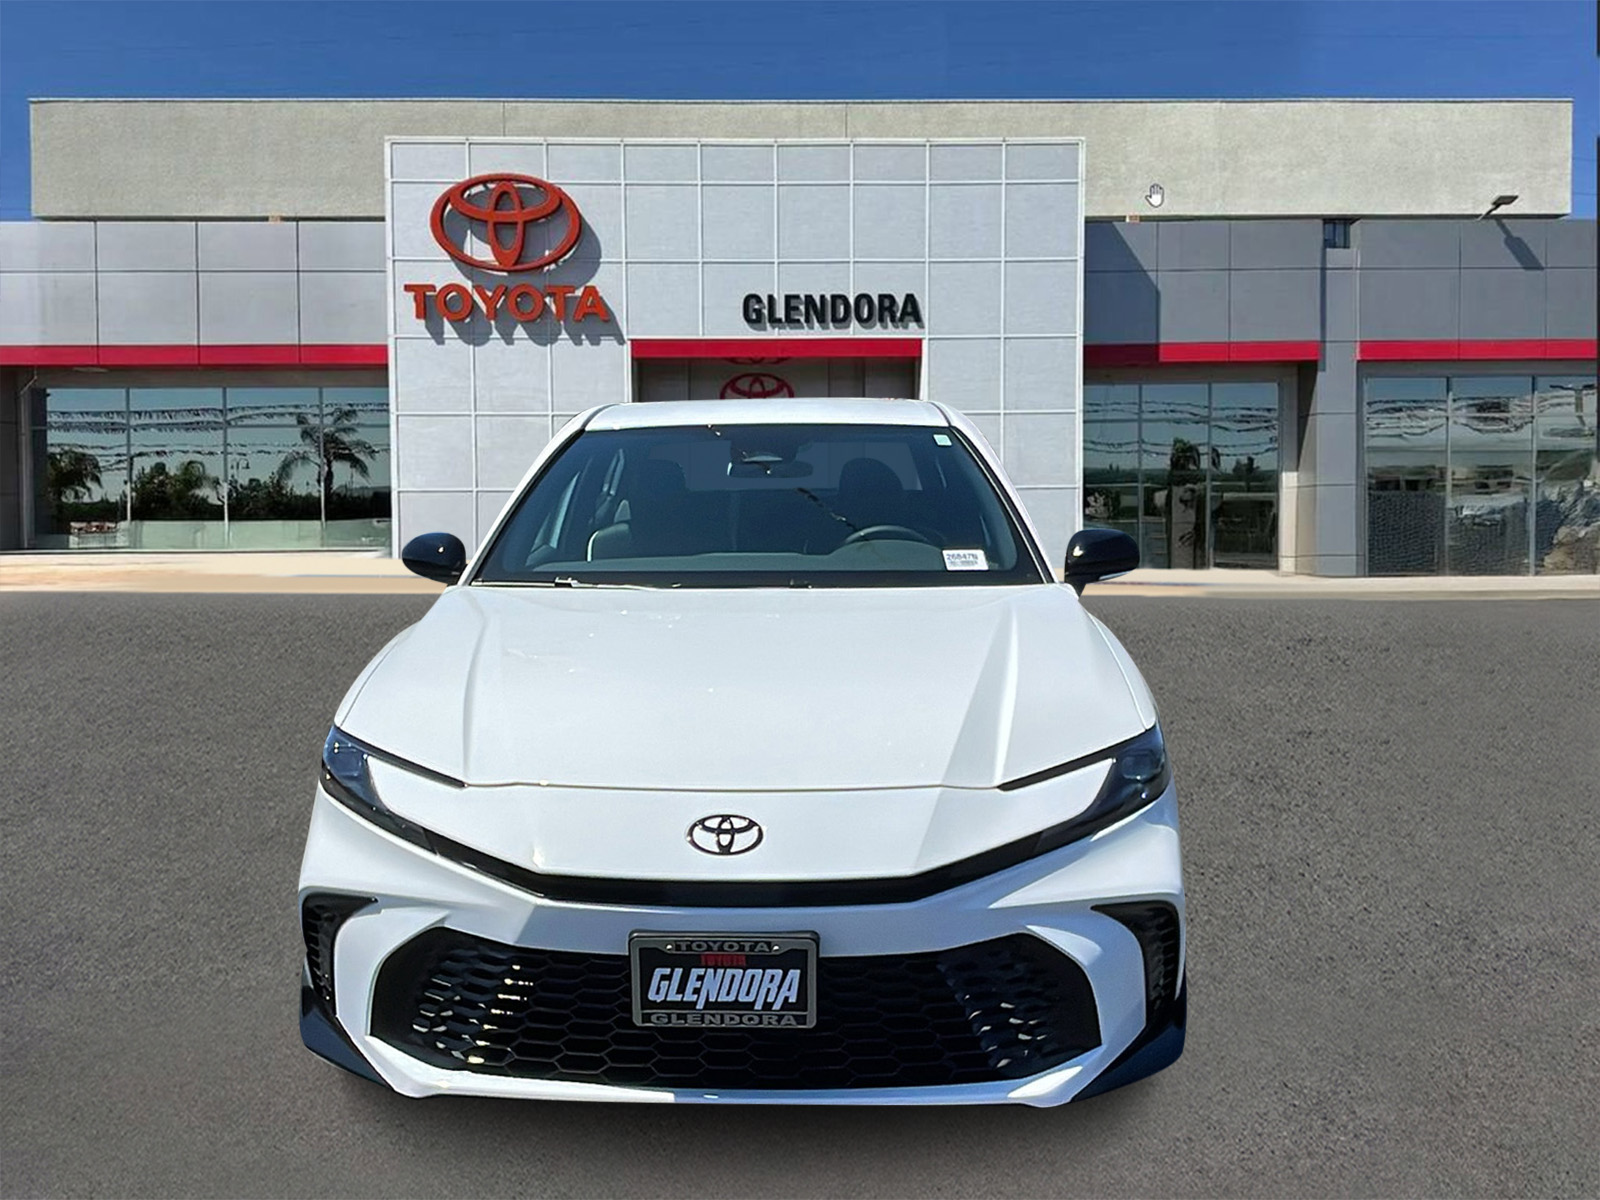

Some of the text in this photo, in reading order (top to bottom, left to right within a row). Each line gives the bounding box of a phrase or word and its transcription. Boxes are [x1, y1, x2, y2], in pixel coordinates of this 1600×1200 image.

[404, 283, 610, 322] TOYOTA
[742, 293, 922, 325] GLENDORA
[675, 941, 770, 952] TOYOTA
[647, 967, 801, 1010] GLENDORA
[650, 1013, 798, 1026] GLENDORA
